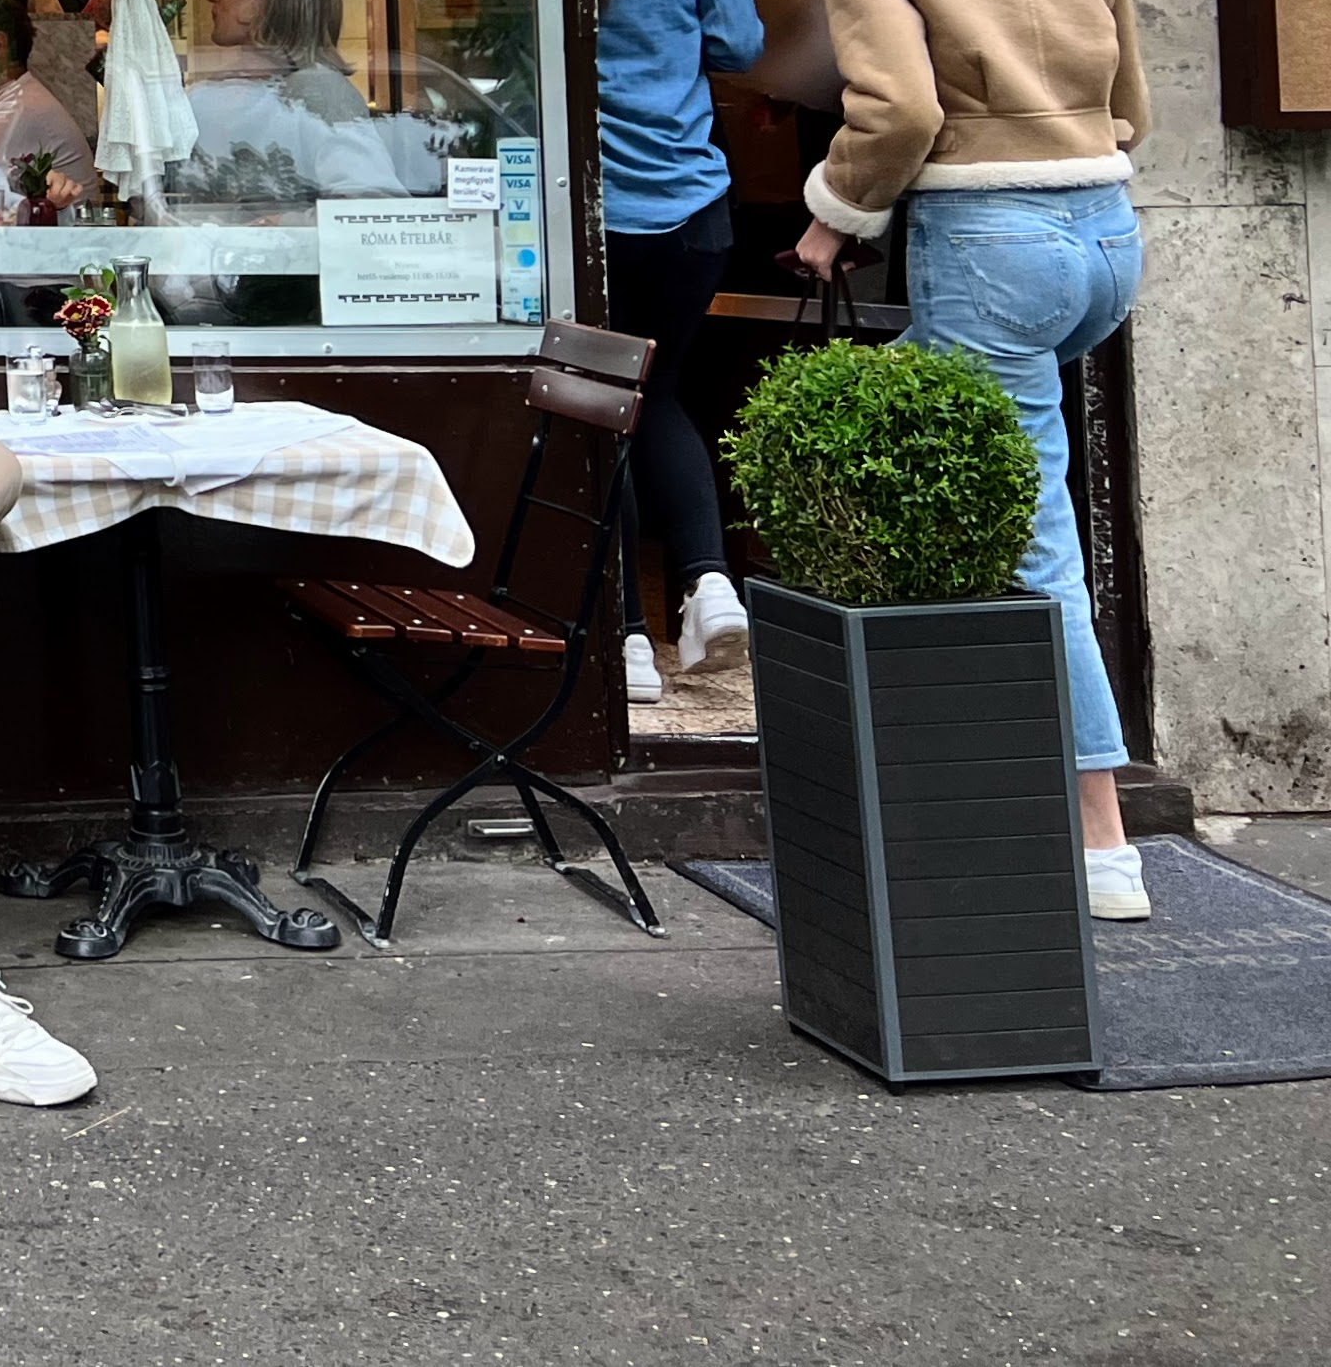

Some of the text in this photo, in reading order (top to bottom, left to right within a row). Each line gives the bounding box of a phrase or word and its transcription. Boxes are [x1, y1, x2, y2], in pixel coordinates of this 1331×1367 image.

[505, 154, 532, 165] VISA
[506, 179, 532, 189] VISA
[360, 230, 454, 246] RÓMA ÉTELBÁR
